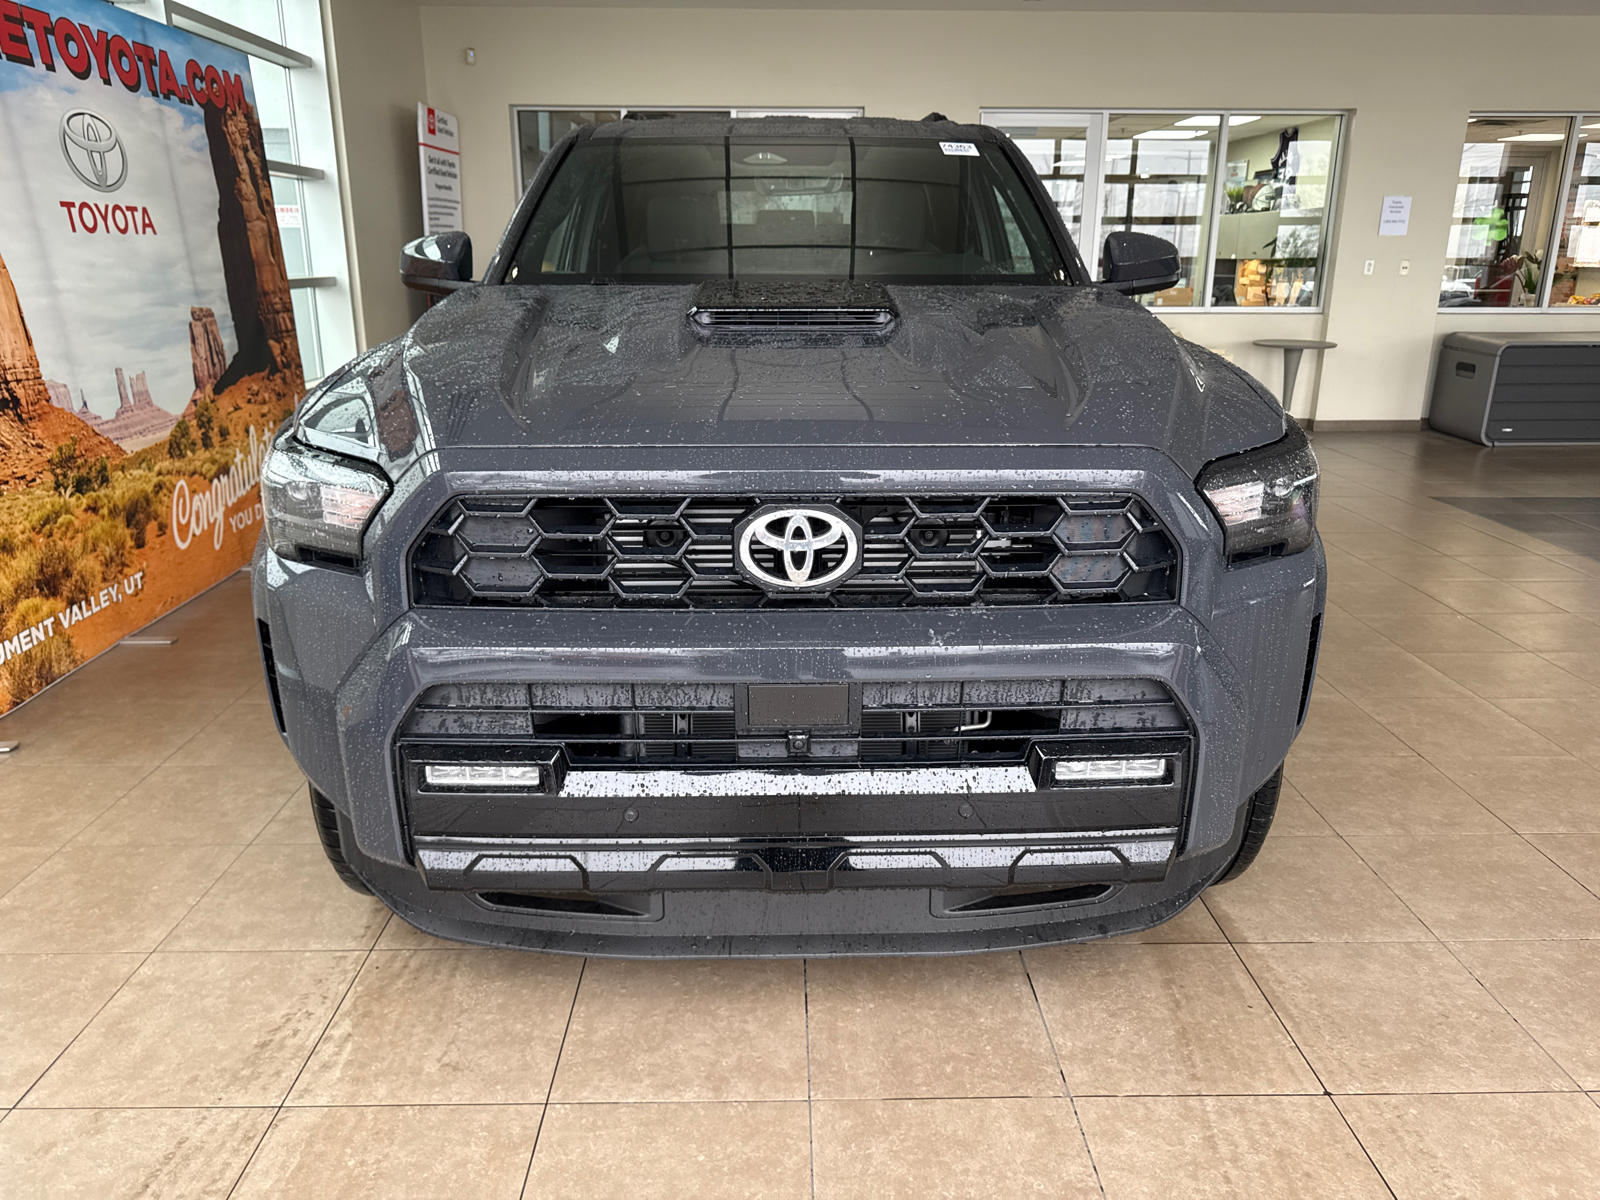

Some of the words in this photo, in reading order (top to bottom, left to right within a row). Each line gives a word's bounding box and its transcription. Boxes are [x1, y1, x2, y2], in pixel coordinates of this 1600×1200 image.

[0, 0, 249, 115] ETOYOTA.COM
[59, 200, 157, 235] TOYOTA
[229, 507, 253, 533] YOU
[58, 583, 122, 629] VALLEY,
[123, 571, 143, 595] UT
